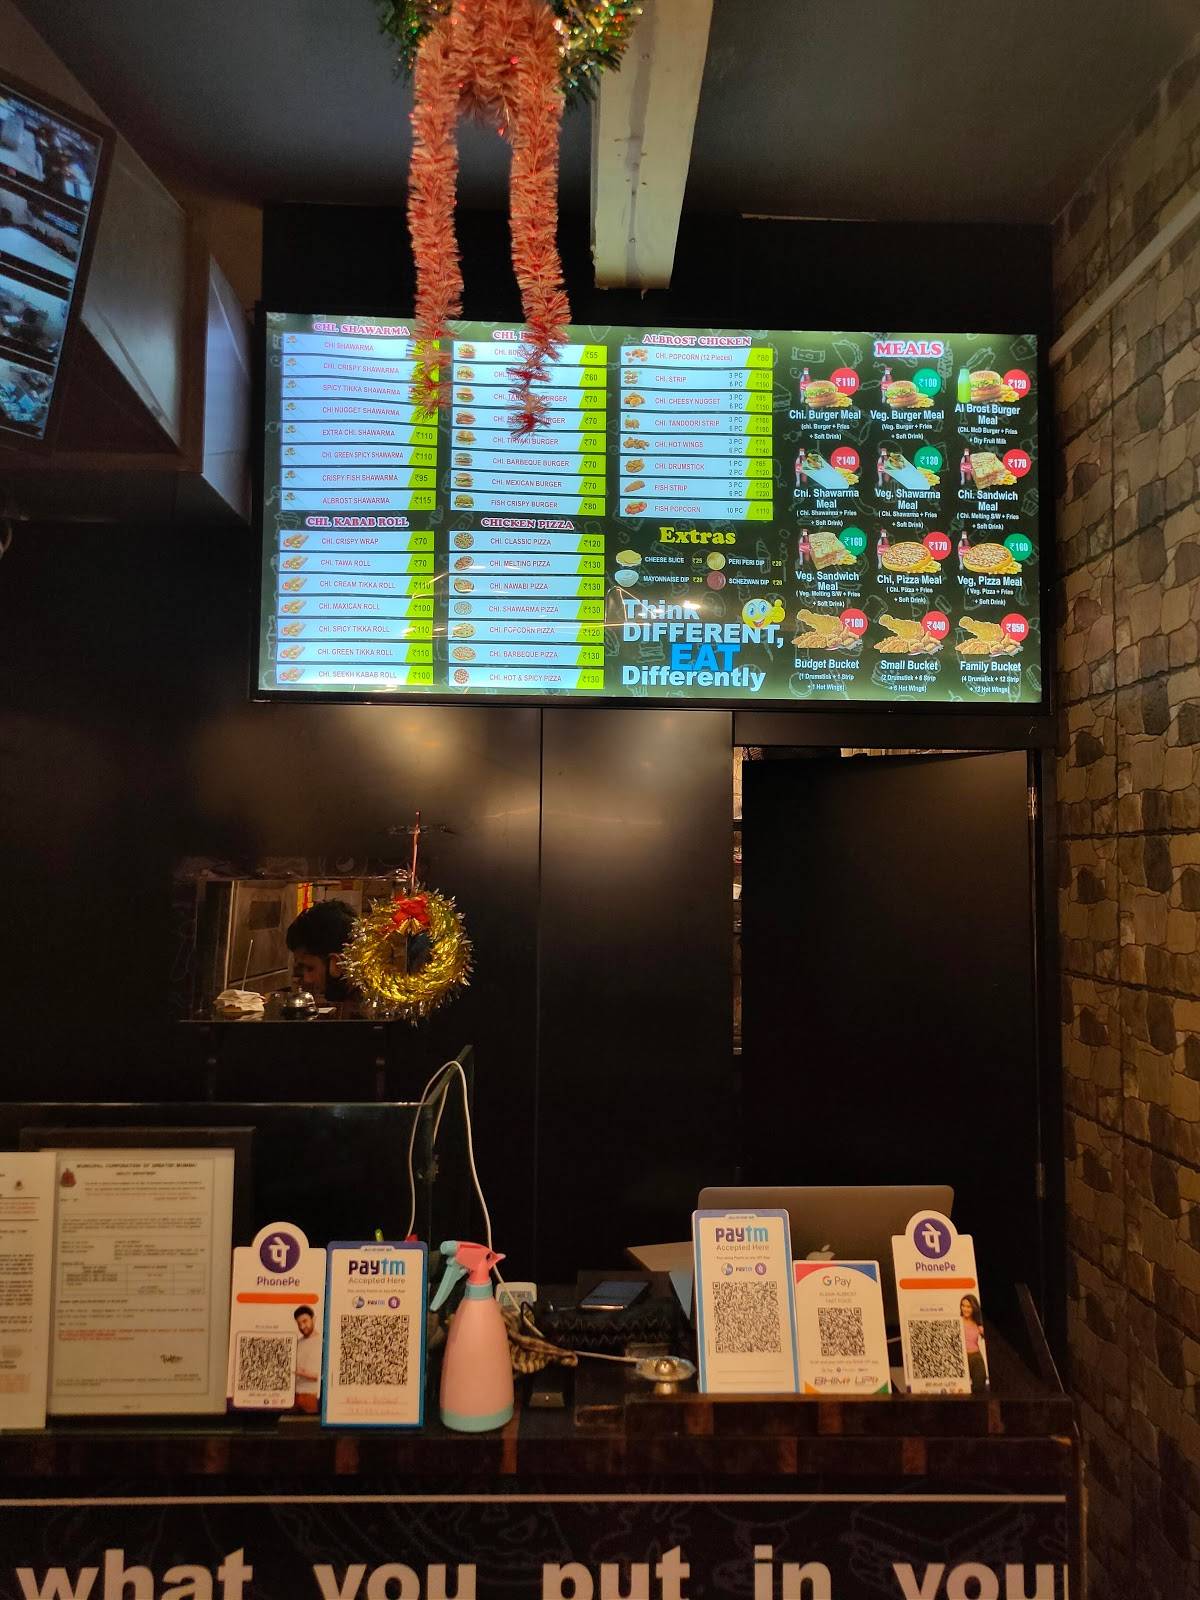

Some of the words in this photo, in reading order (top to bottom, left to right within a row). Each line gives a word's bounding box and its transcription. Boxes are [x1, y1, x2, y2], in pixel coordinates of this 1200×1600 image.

[313, 323, 339, 333] CHI.
[342, 324, 410, 336] SHAWARMA
[493, 331, 517, 340] CHI.
[642, 334, 696, 346] ALBROST
[698, 336, 752, 346] CHICKEN
[874, 340, 944, 358] MEALS
[836, 378, 855, 386] ₹110
[967, 404, 990, 413] Brost
[992, 405, 1020, 416] Burger
[789, 410, 806, 419] Chi.
[809, 411, 838, 421] Burger
[841, 411, 861, 419] Meal
[870, 410, 889, 421] Veg.
[892, 410, 922, 421] Burger
[924, 411, 944, 420] Meal
[978, 416, 998, 425] Meal
[416, 431, 433, 440] ₹110
[1008, 458, 1026, 468] ₹170
[415, 474, 428, 482] ₹95
[584, 482, 596, 490] ₹70
[794, 489, 811, 498] Chi.
[813, 489, 859, 497] Shawarma
[875, 488, 894, 499] Veg.
[896, 489, 940, 499] Shawarma
[958, 490, 974, 499] Chi.
[977, 491, 1018, 500] Sandwich
[414, 496, 432, 505] ₹115
[817, 500, 837, 508] Meal
[898, 500, 917, 509] Meal
[584, 503, 596, 511] ₹80
[978, 502, 998, 511] Meal
[306, 517, 332, 527] CHI.
[334, 518, 375, 527] KABAB
[377, 518, 409, 527] ROLL
[481, 518, 536, 527] CHICKEN
[538, 520, 574, 530] PIZZA
[659, 527, 736, 544] Extras
[929, 541, 947, 551] ₹170
[795, 571, 814, 580] Veg.
[817, 571, 859, 580] Sandwich
[897, 575, 919, 583] Pizza
[922, 576, 942, 584] Meal
[818, 582, 838, 590] Meal
[979, 576, 1001, 585] Pizza
[1003, 577, 1022, 586] Meal
[623, 599, 699, 620] Think
[623, 622, 784, 648] DIFFERENT,
[412, 649, 429, 657] ₹110
[671, 643, 741, 672] EAT
[795, 659, 826, 671] Budget
[828, 659, 859, 668] Bucket
[881, 661, 905, 670] Small
[908, 661, 938, 670] Bucket
[960, 661, 989, 673] Family
[991, 662, 1021, 671] Bucket
[622, 665, 766, 692] Differently
[716, 1225, 768, 1242] paytm
[922, 1223, 941, 1252] पे
[270, 1237, 290, 1268] पे
[349, 1258, 405, 1275] paytm
[916, 1262, 956, 1271] PhonePe
[257, 1276, 300, 1286] PhonePe
[349, 1277, 385, 1285] Accepted
[823, 1276, 831, 1286] G
[835, 1276, 851, 1287] Pay
[16, 1547, 253, 1600] what
[312, 1563, 477, 1600] you
[542, 1546, 690, 1600] put
[754, 1545, 832, 1600] in
[893, 1562, 1069, 1600] you
